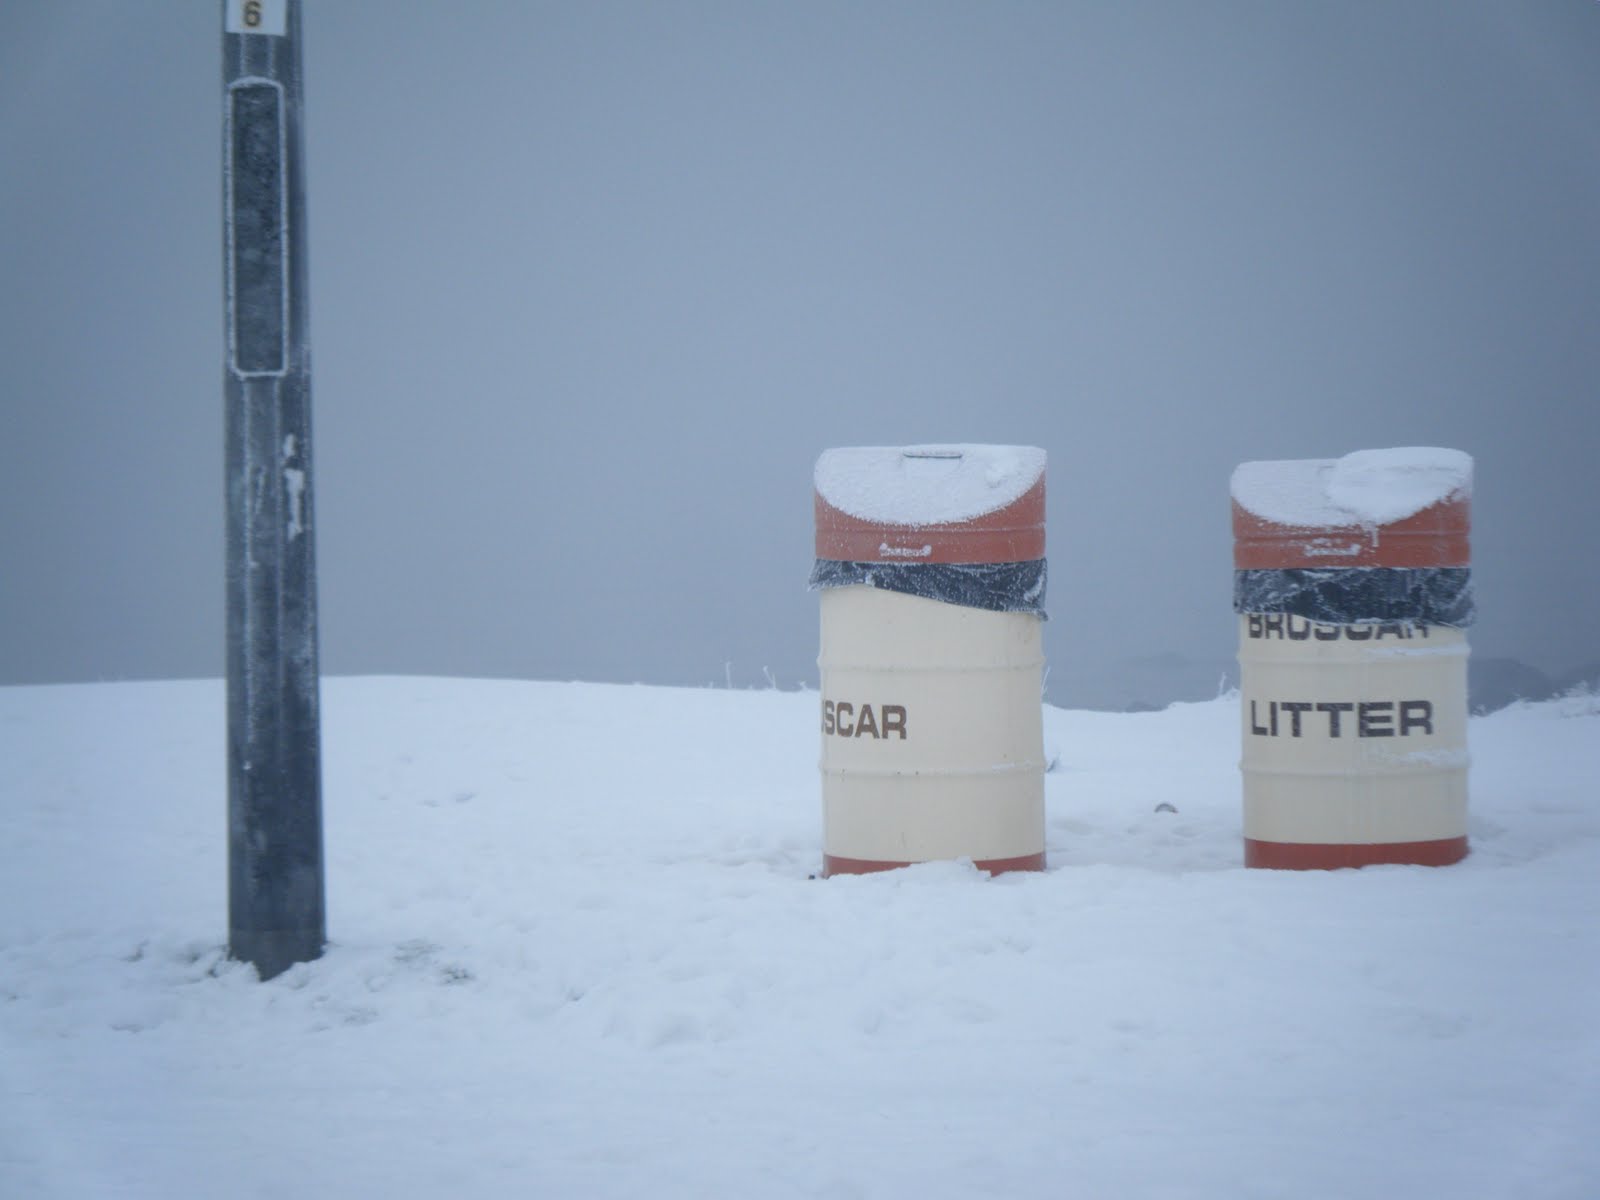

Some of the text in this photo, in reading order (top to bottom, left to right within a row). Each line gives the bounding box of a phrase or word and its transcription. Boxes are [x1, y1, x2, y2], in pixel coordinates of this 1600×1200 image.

[243, 1, 262, 26] 6
[821, 700, 907, 740] SCAR
[1251, 700, 1434, 738] LITTER
